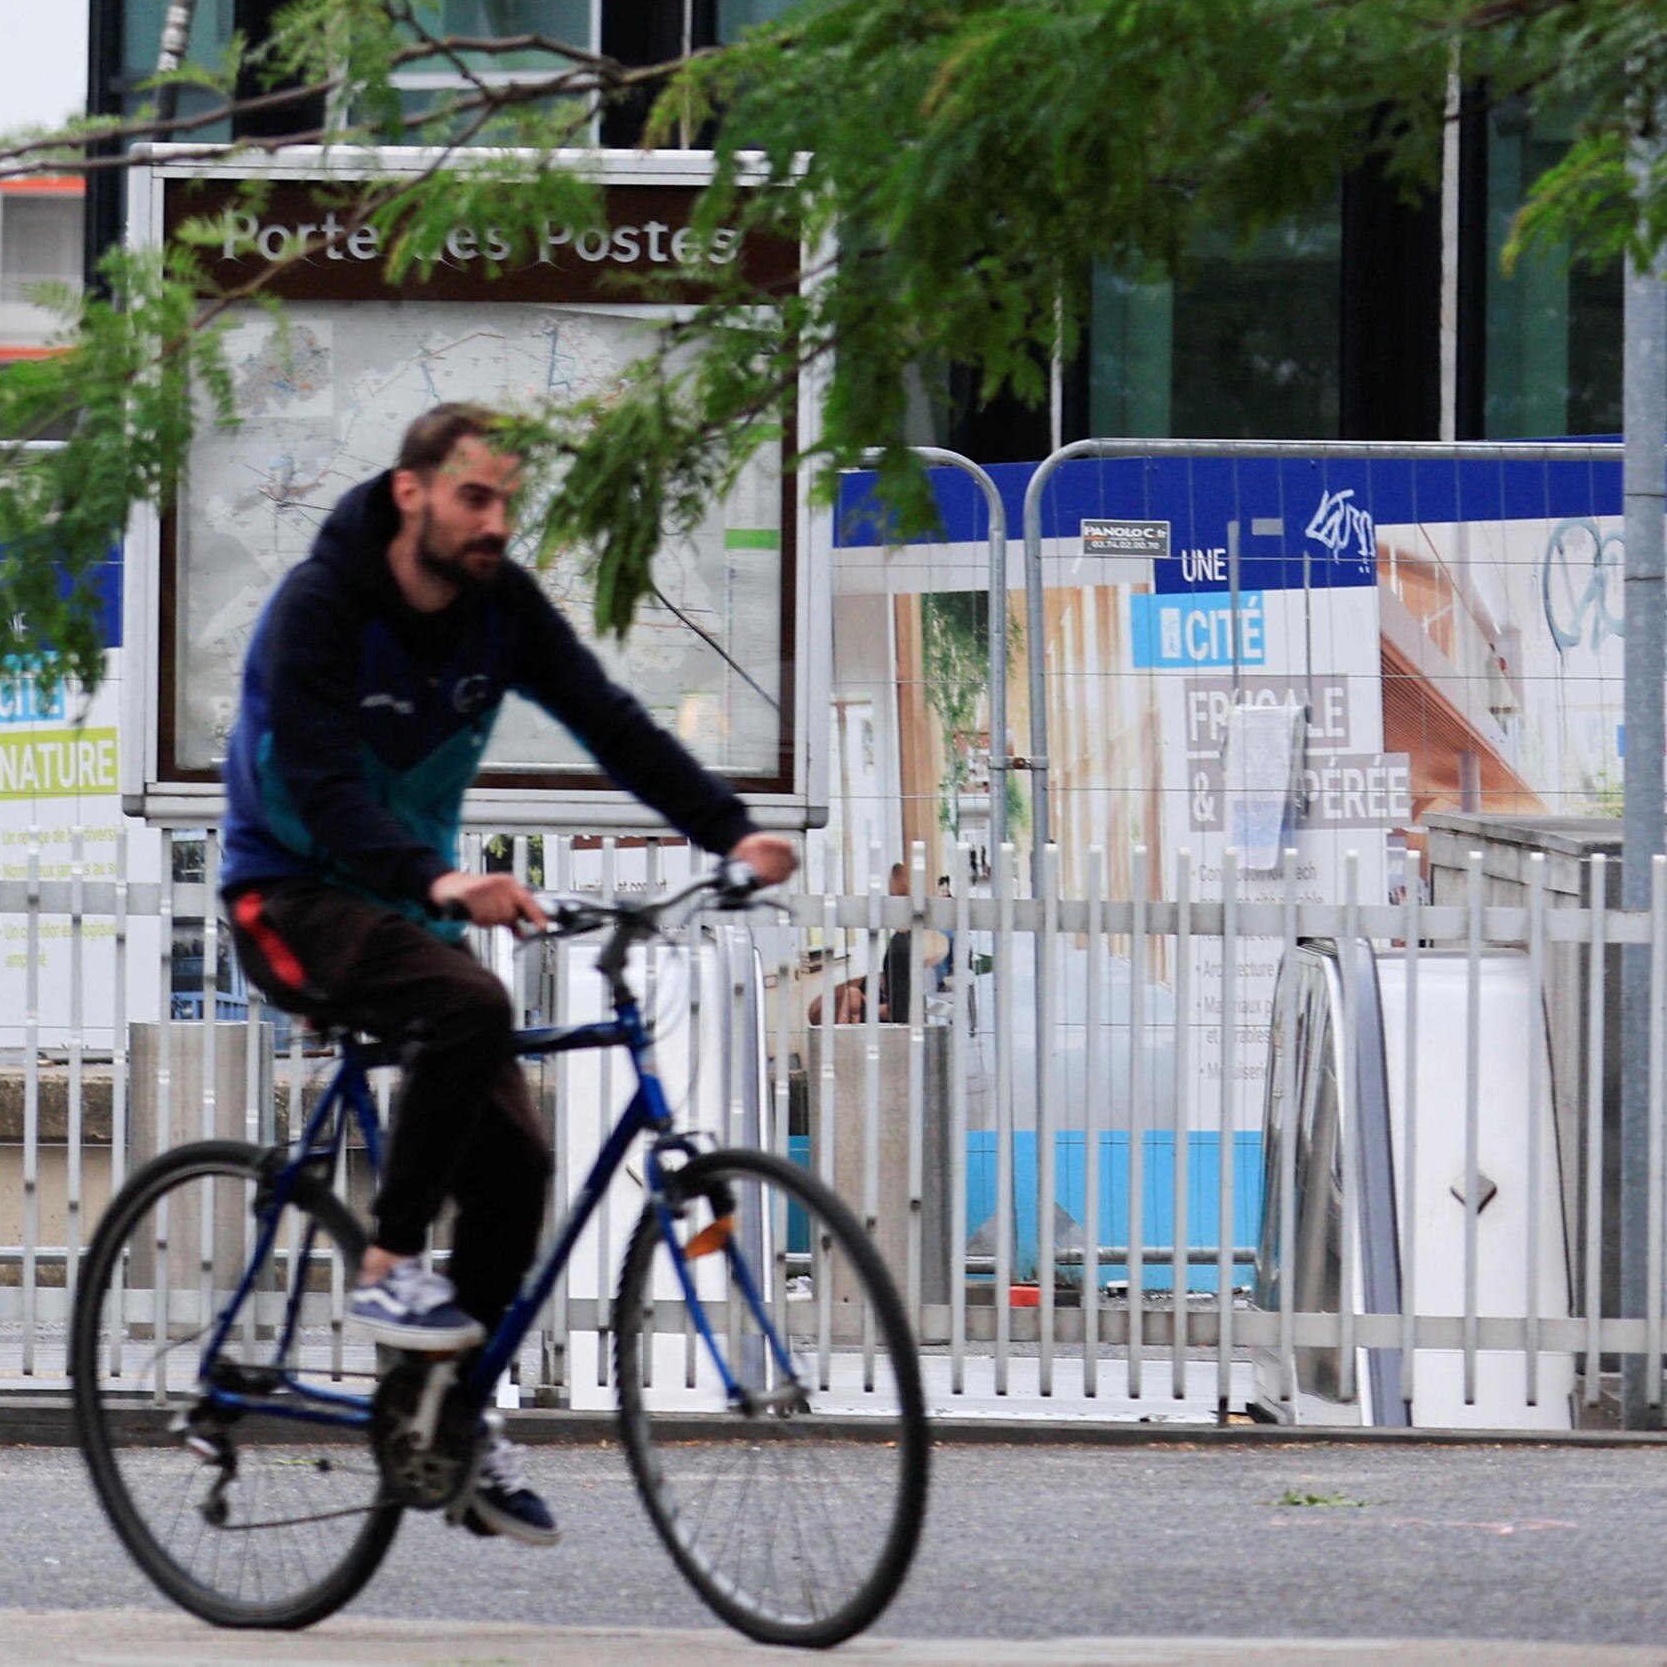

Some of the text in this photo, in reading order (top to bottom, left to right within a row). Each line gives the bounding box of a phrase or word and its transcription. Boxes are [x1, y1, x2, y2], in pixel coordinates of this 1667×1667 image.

[223, 210, 746, 264] Porte es Postes
[1182, 548, 1227, 582] UNE
[1185, 596, 1263, 661] CITÉ
[1192, 771, 1216, 822] &
